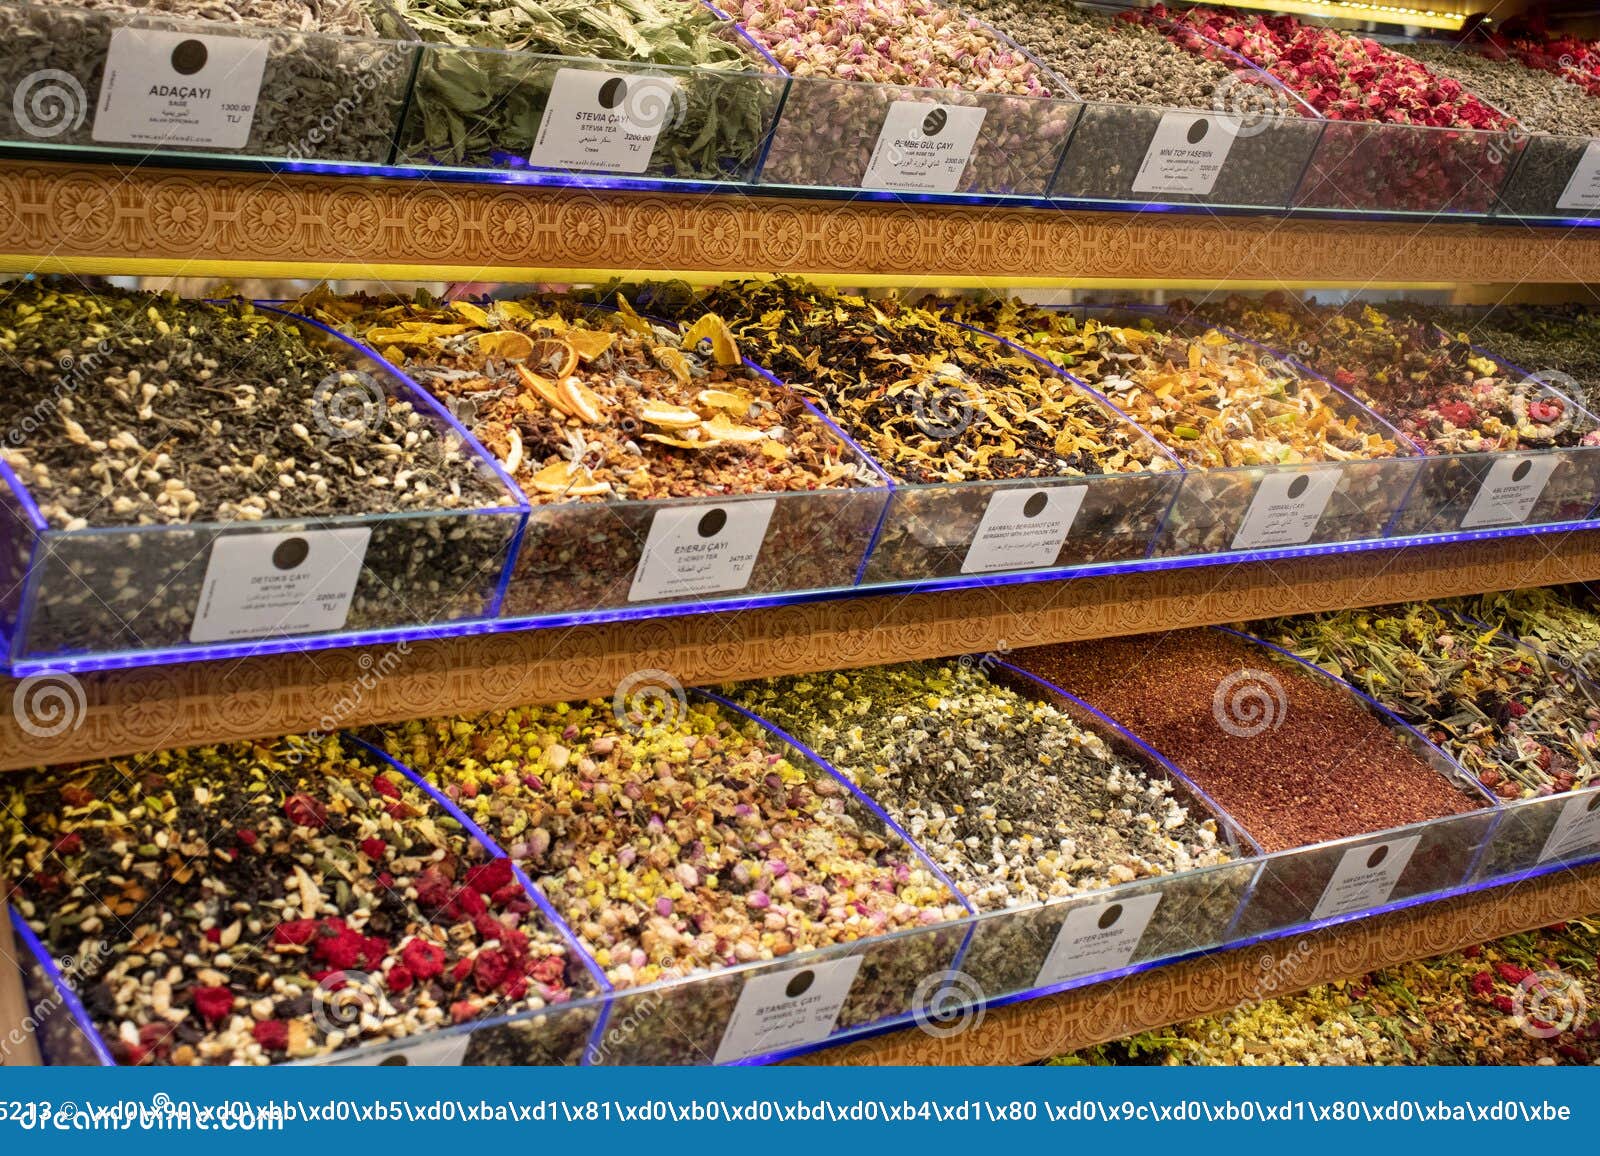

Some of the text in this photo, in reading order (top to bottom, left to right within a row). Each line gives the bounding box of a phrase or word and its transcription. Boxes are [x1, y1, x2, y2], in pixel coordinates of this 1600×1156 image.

[149, 85, 211, 99] ADAÇAYI
[575, 112, 606, 122] STEVIA
[580, 124, 617, 133] STEVIA TEA
